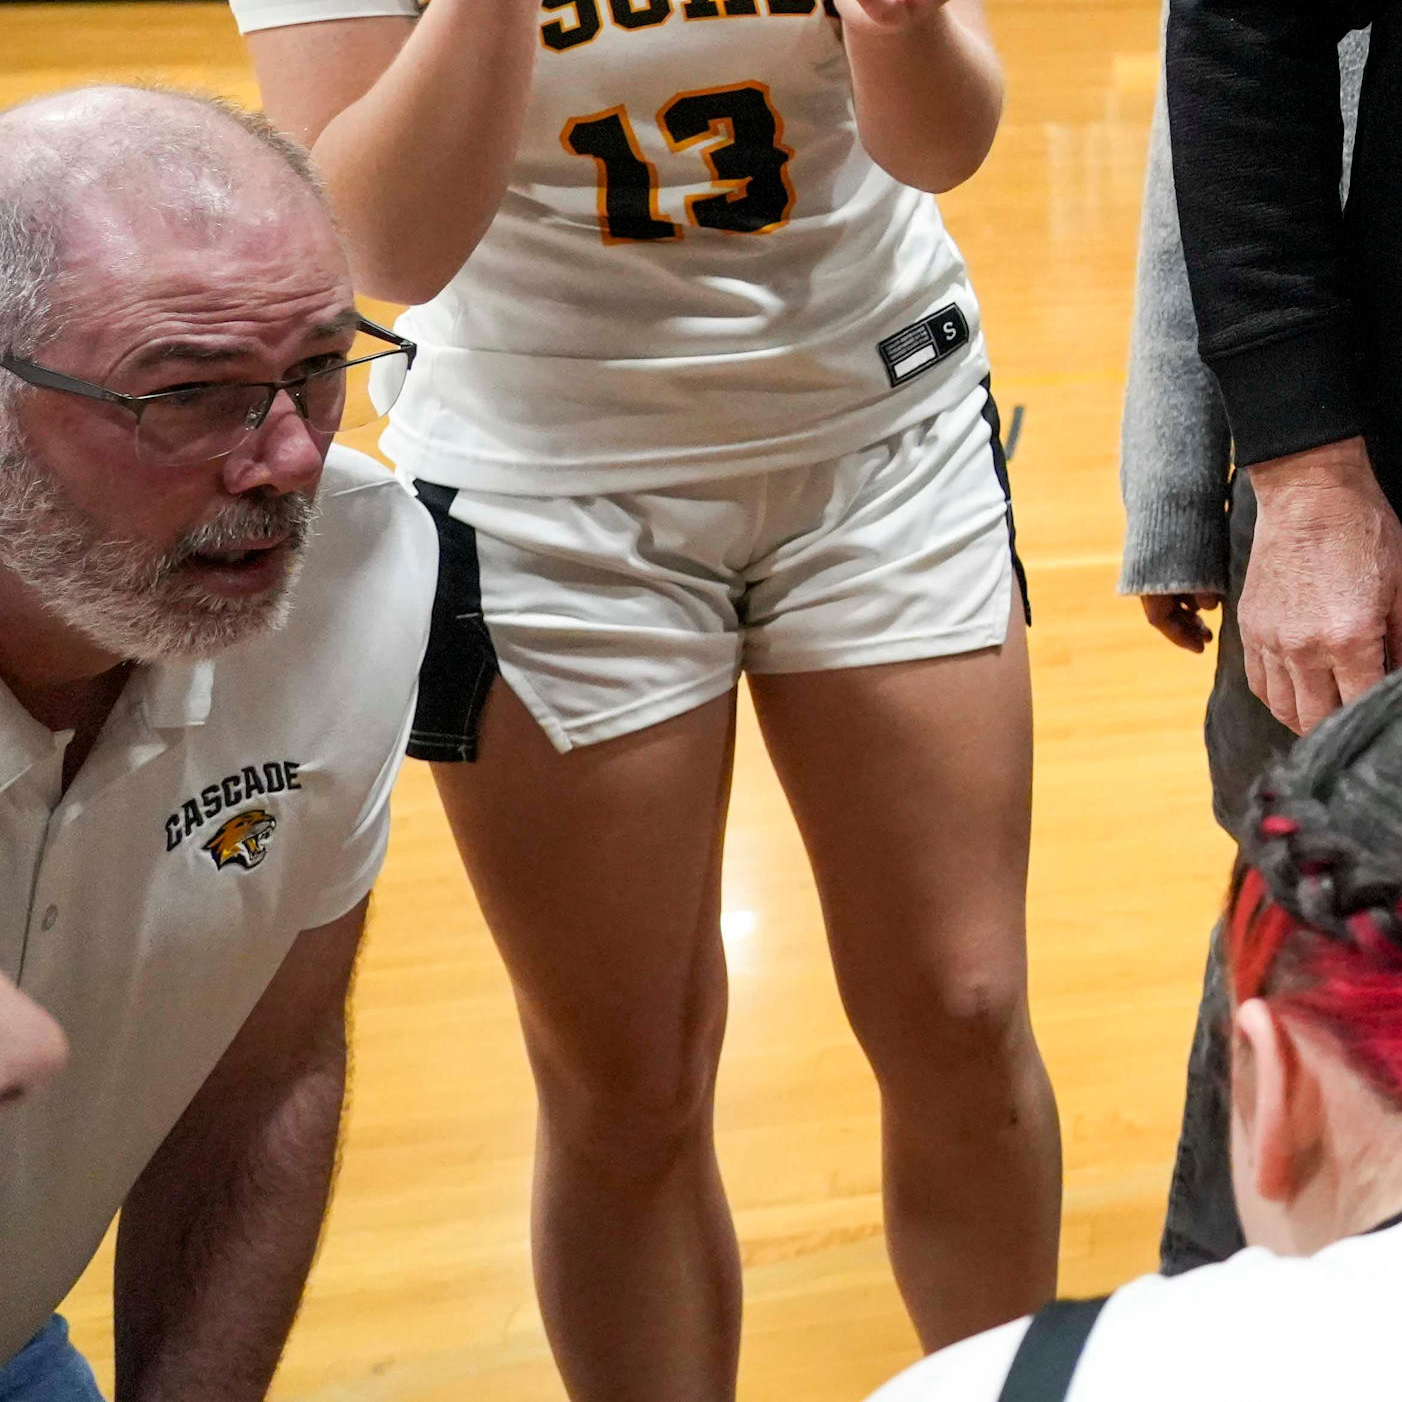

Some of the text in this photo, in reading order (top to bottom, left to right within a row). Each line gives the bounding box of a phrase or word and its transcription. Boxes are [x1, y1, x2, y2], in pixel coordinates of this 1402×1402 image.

[560, 80, 796, 246] 13
[942, 321, 957, 341] S
[165, 761, 302, 852] CASCADE
